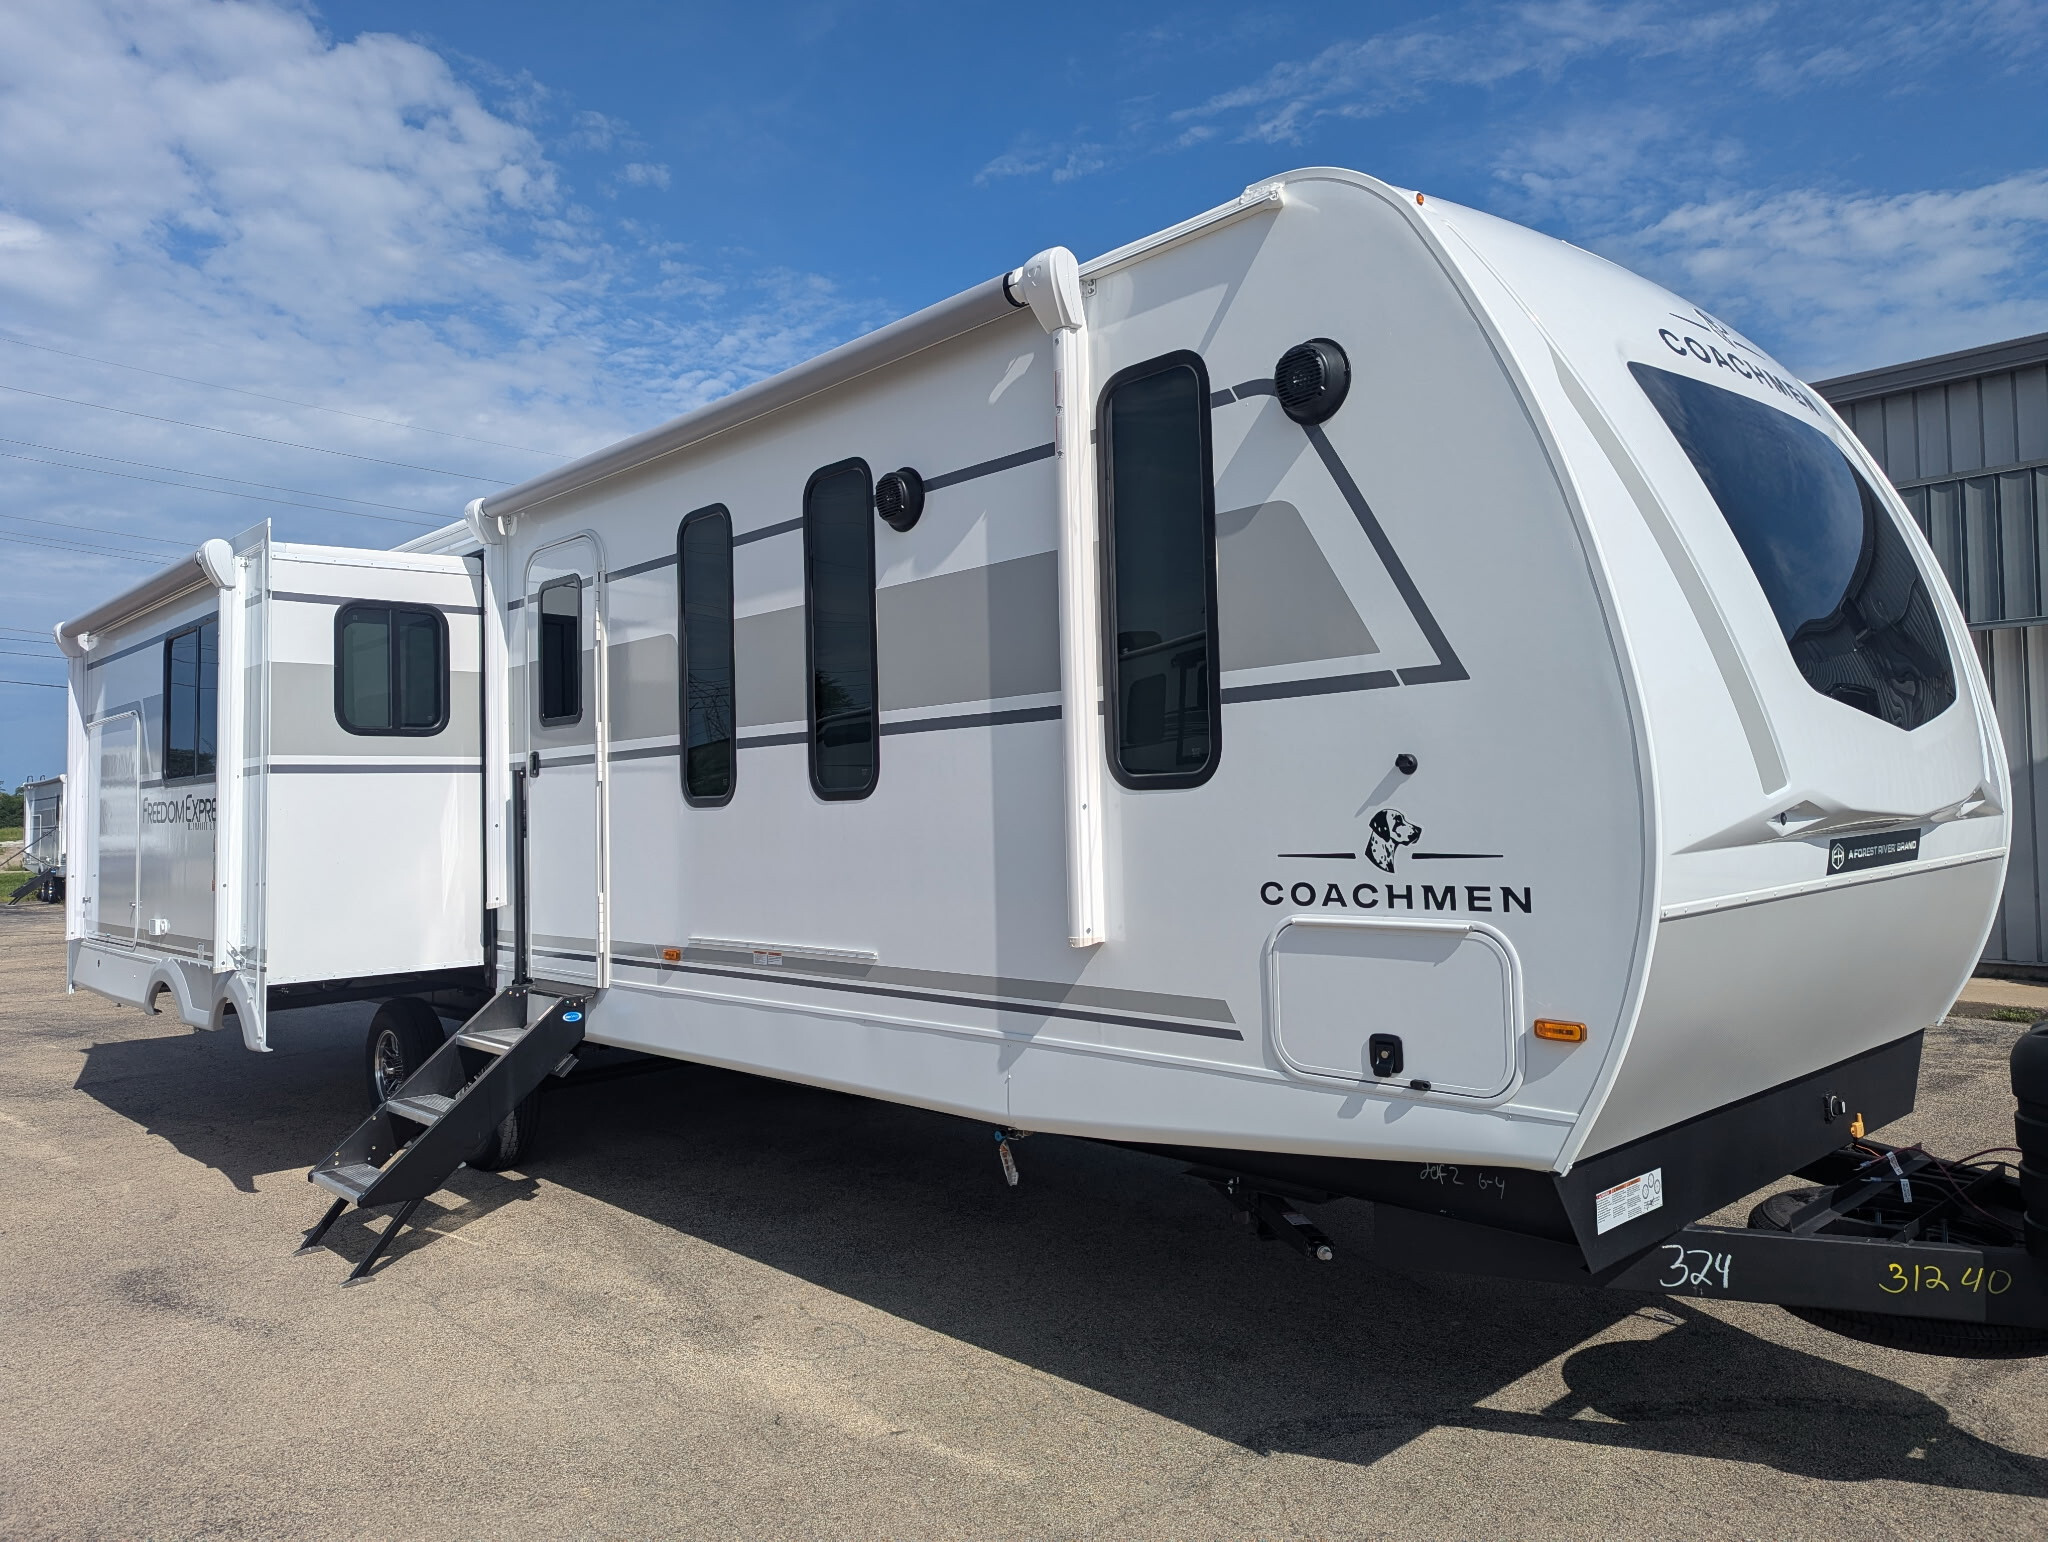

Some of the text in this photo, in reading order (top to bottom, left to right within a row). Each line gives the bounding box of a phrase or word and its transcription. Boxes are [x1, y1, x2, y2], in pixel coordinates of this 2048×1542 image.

[1658, 328, 1821, 416] COACHMEN
[1854, 847, 1878, 858] FOREST
[1878, 843, 1896, 854] RIVER
[1897, 840, 1917, 852] BRAND
[1260, 881, 1532, 914] COACHMEN
[1659, 1244, 1732, 1288] 324
